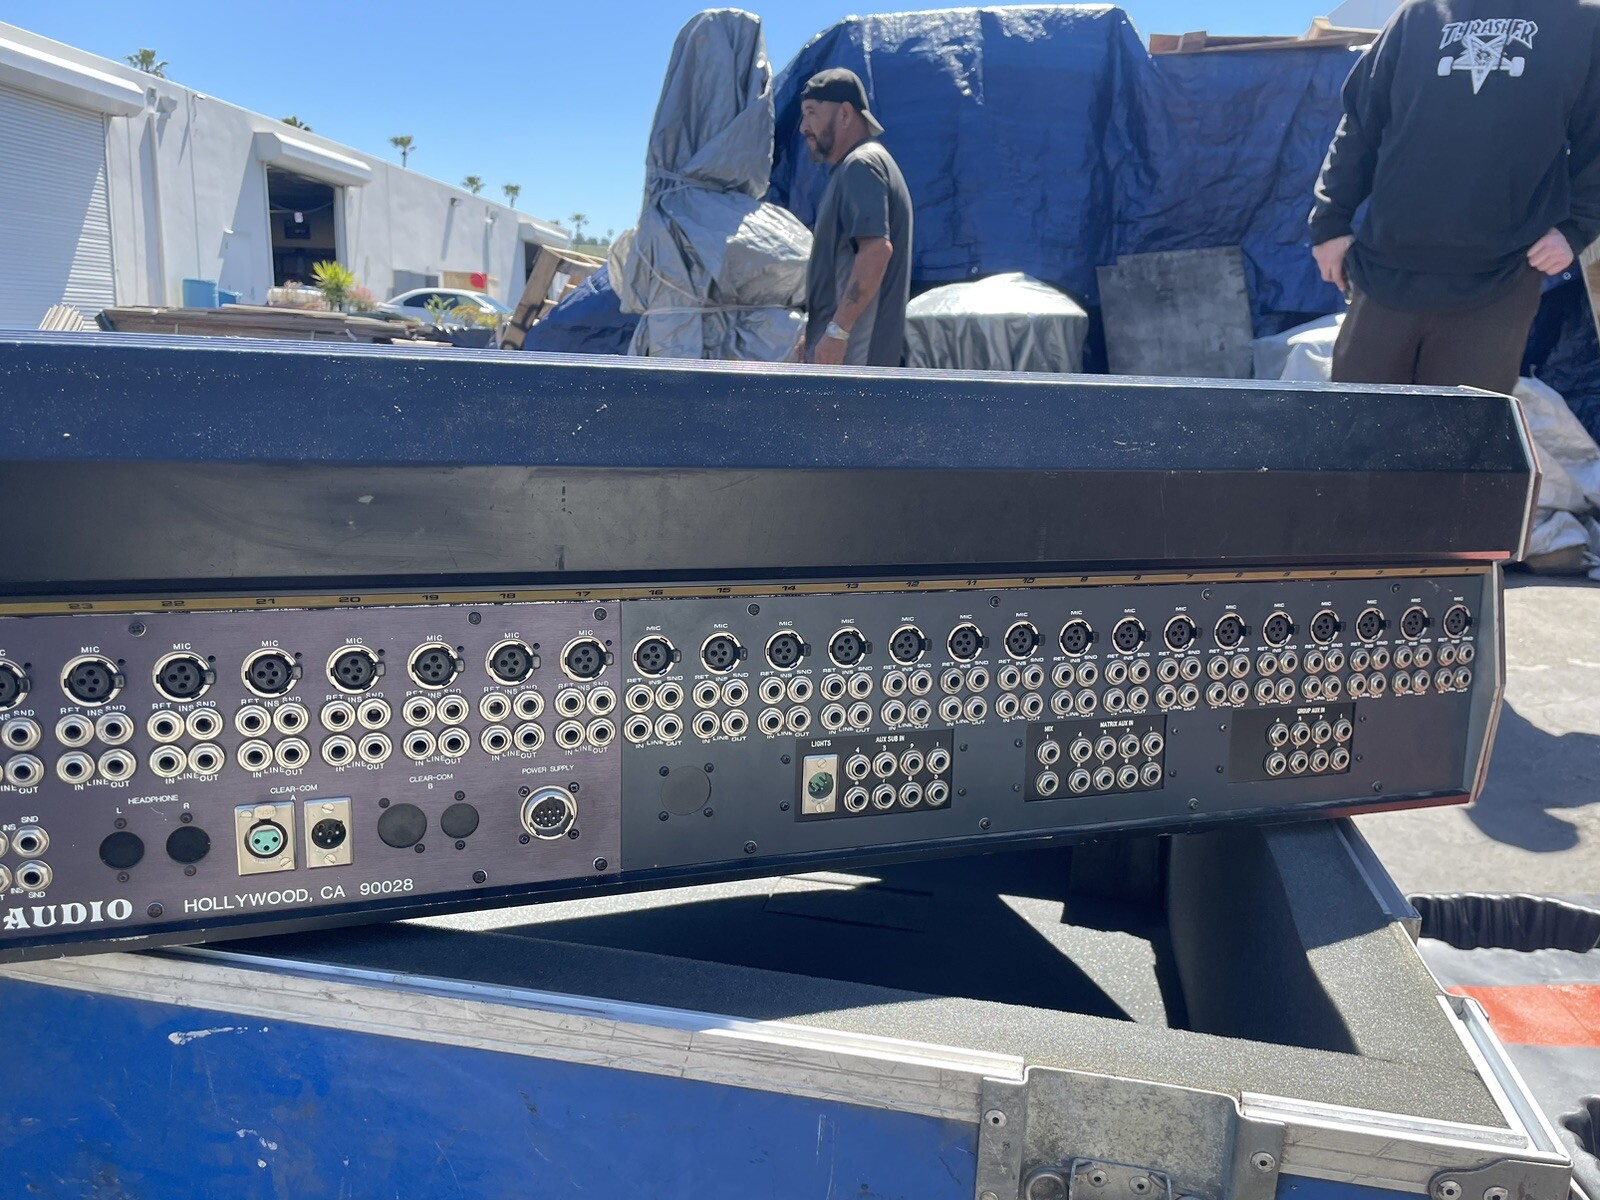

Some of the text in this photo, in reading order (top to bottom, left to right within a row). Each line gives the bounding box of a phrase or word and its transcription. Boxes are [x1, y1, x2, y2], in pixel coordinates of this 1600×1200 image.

[1439, 19, 1538, 50] THRASHER
[81, 646, 100, 654] MIC
[264, 700, 279, 708] INS
[13, 709, 35, 717] SND
[502, 750, 520, 758] LINE
[346, 761, 366, 769] LINE
[367, 763, 385, 771] OUT
[522, 764, 574, 775] POWER SUPPLY
[200, 774, 219, 782] OUT
[409, 774, 454, 783] CLEAR-COM
[110, 780, 130, 788] OUT
[18, 786, 39, 794] OUT
[270, 784, 318, 794] CLEAR-COM
[128, 794, 179, 804] HEADPHONE
[21, 816, 39, 824] SND
[3, 824, 16, 832] INS
[10, 887, 24, 895] INS
[184, 878, 414, 914] HOLLYWOOD, CA 90028
[3, 899, 133, 930] AUDIO
